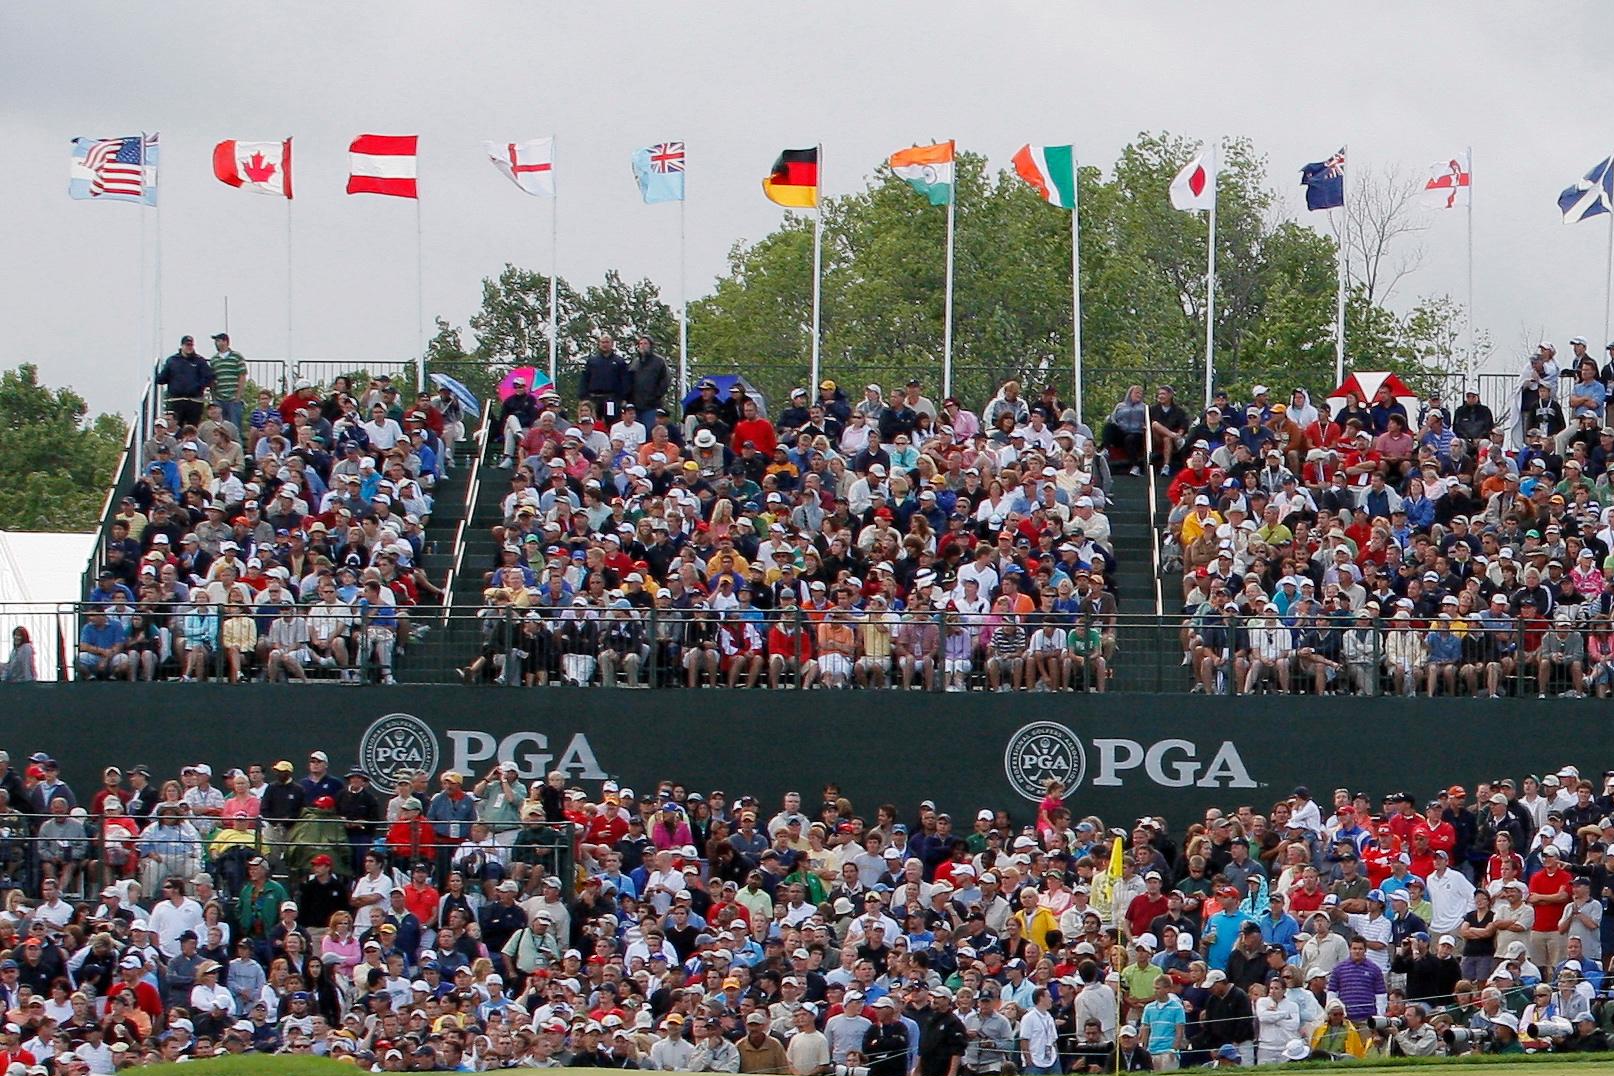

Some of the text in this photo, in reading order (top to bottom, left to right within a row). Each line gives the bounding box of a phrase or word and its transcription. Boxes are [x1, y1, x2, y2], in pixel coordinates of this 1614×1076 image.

[376, 747, 423, 762] PGA
[446, 729, 609, 780] PGA
[1022, 754, 1070, 770] PGA
[1092, 738, 1258, 788] PGA
